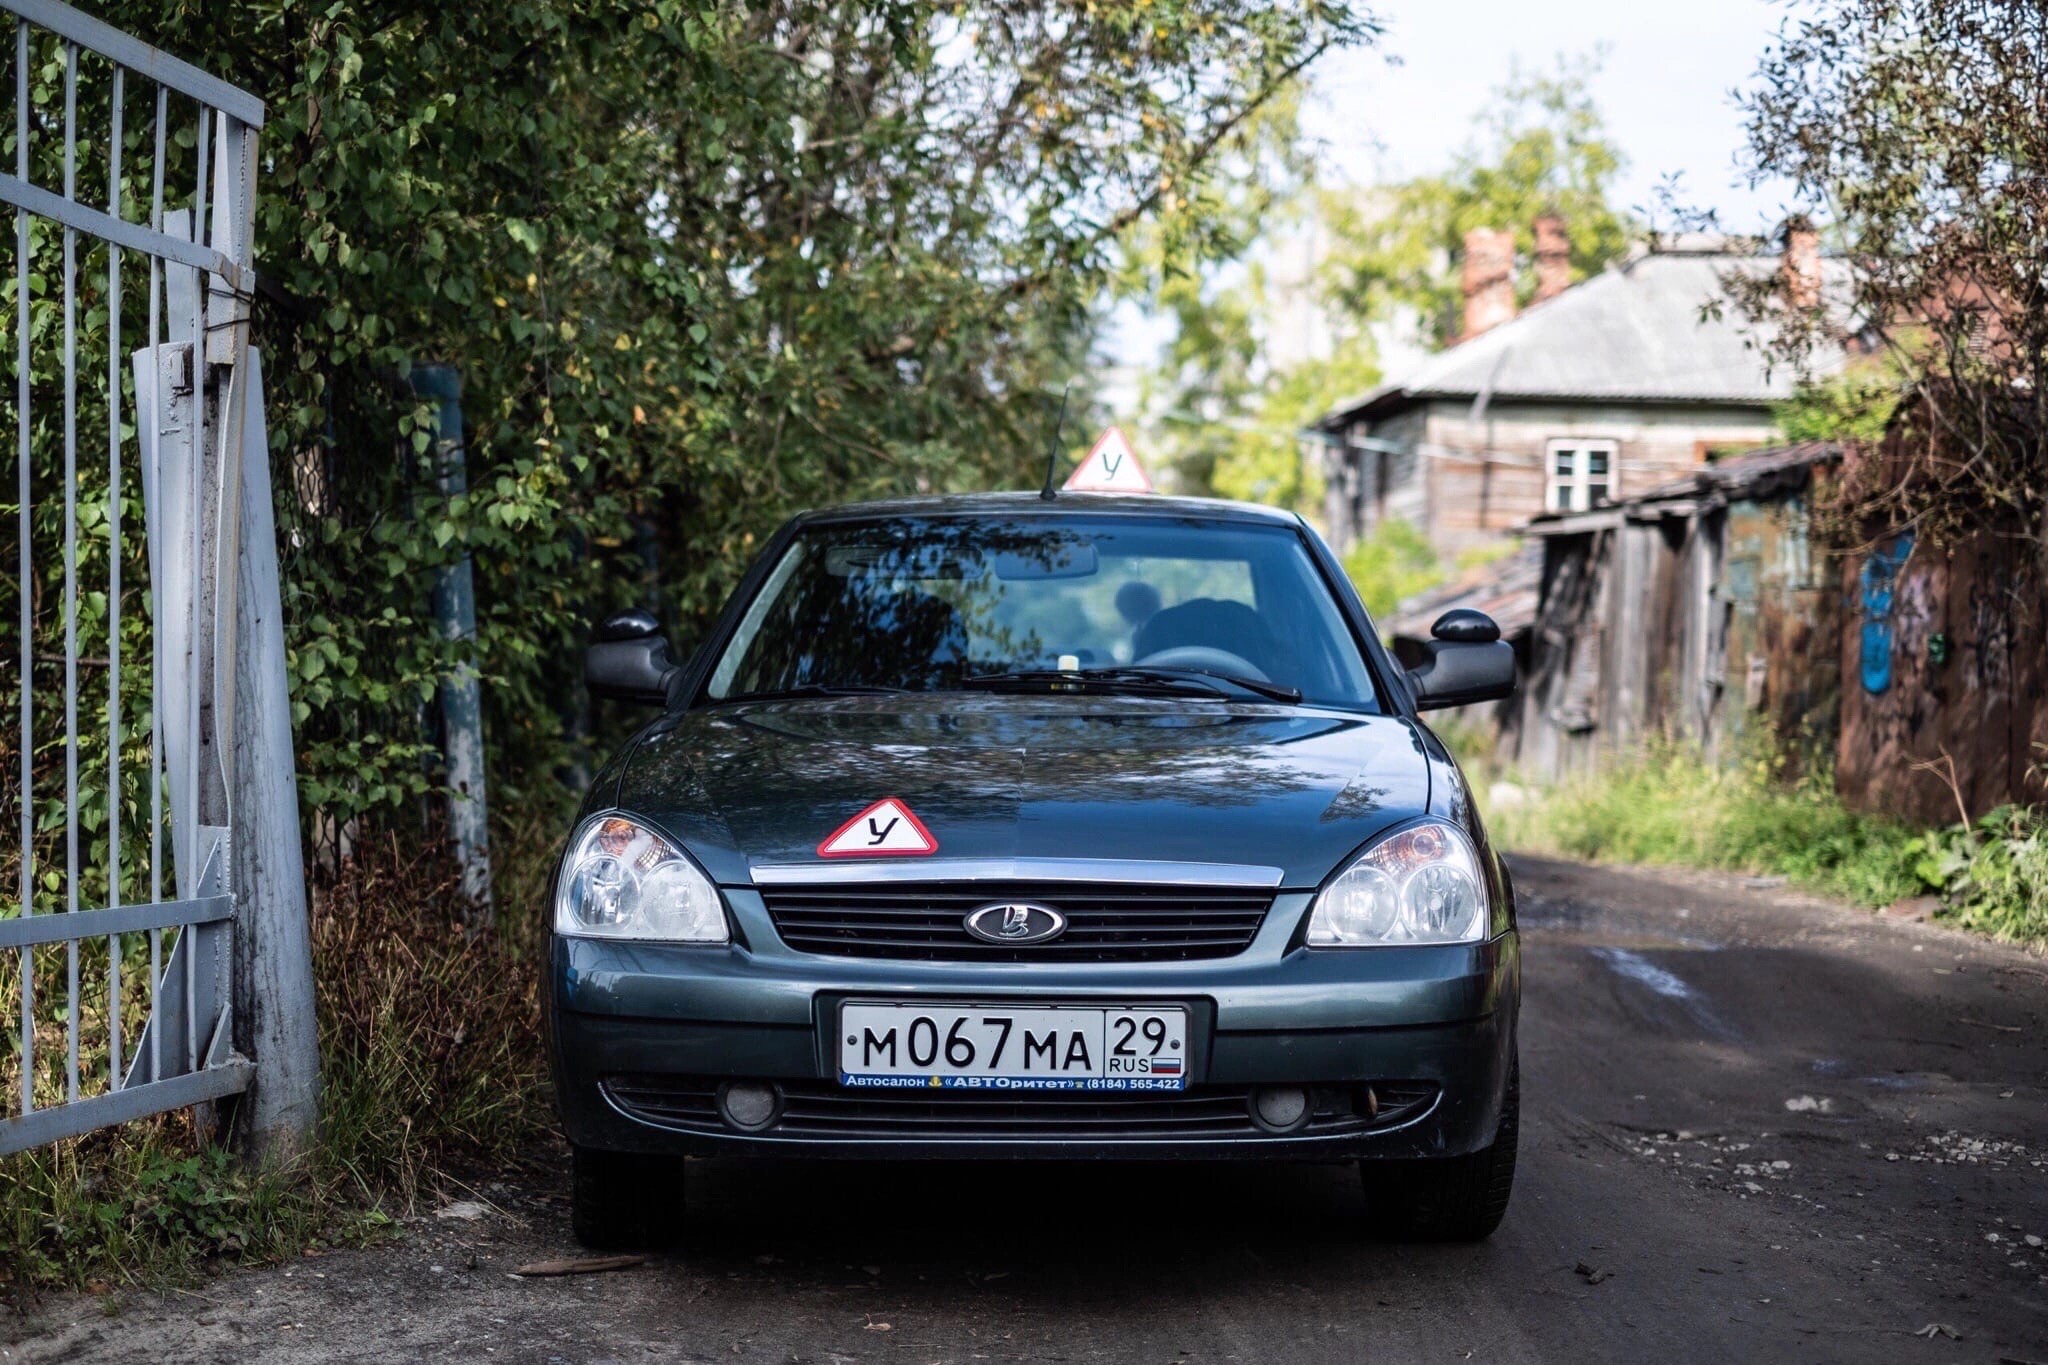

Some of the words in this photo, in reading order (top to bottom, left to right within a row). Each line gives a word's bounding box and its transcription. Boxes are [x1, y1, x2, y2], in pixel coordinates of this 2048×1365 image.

[868, 817, 900, 846] У
[1113, 1016, 1166, 1056] 29
[1109, 1058, 1149, 1072] RUS
[846, 1075, 925, 1087] Автосалон
[1087, 1079, 1126, 1090] (8184)
[1130, 1079, 1180, 1089] 565-422
